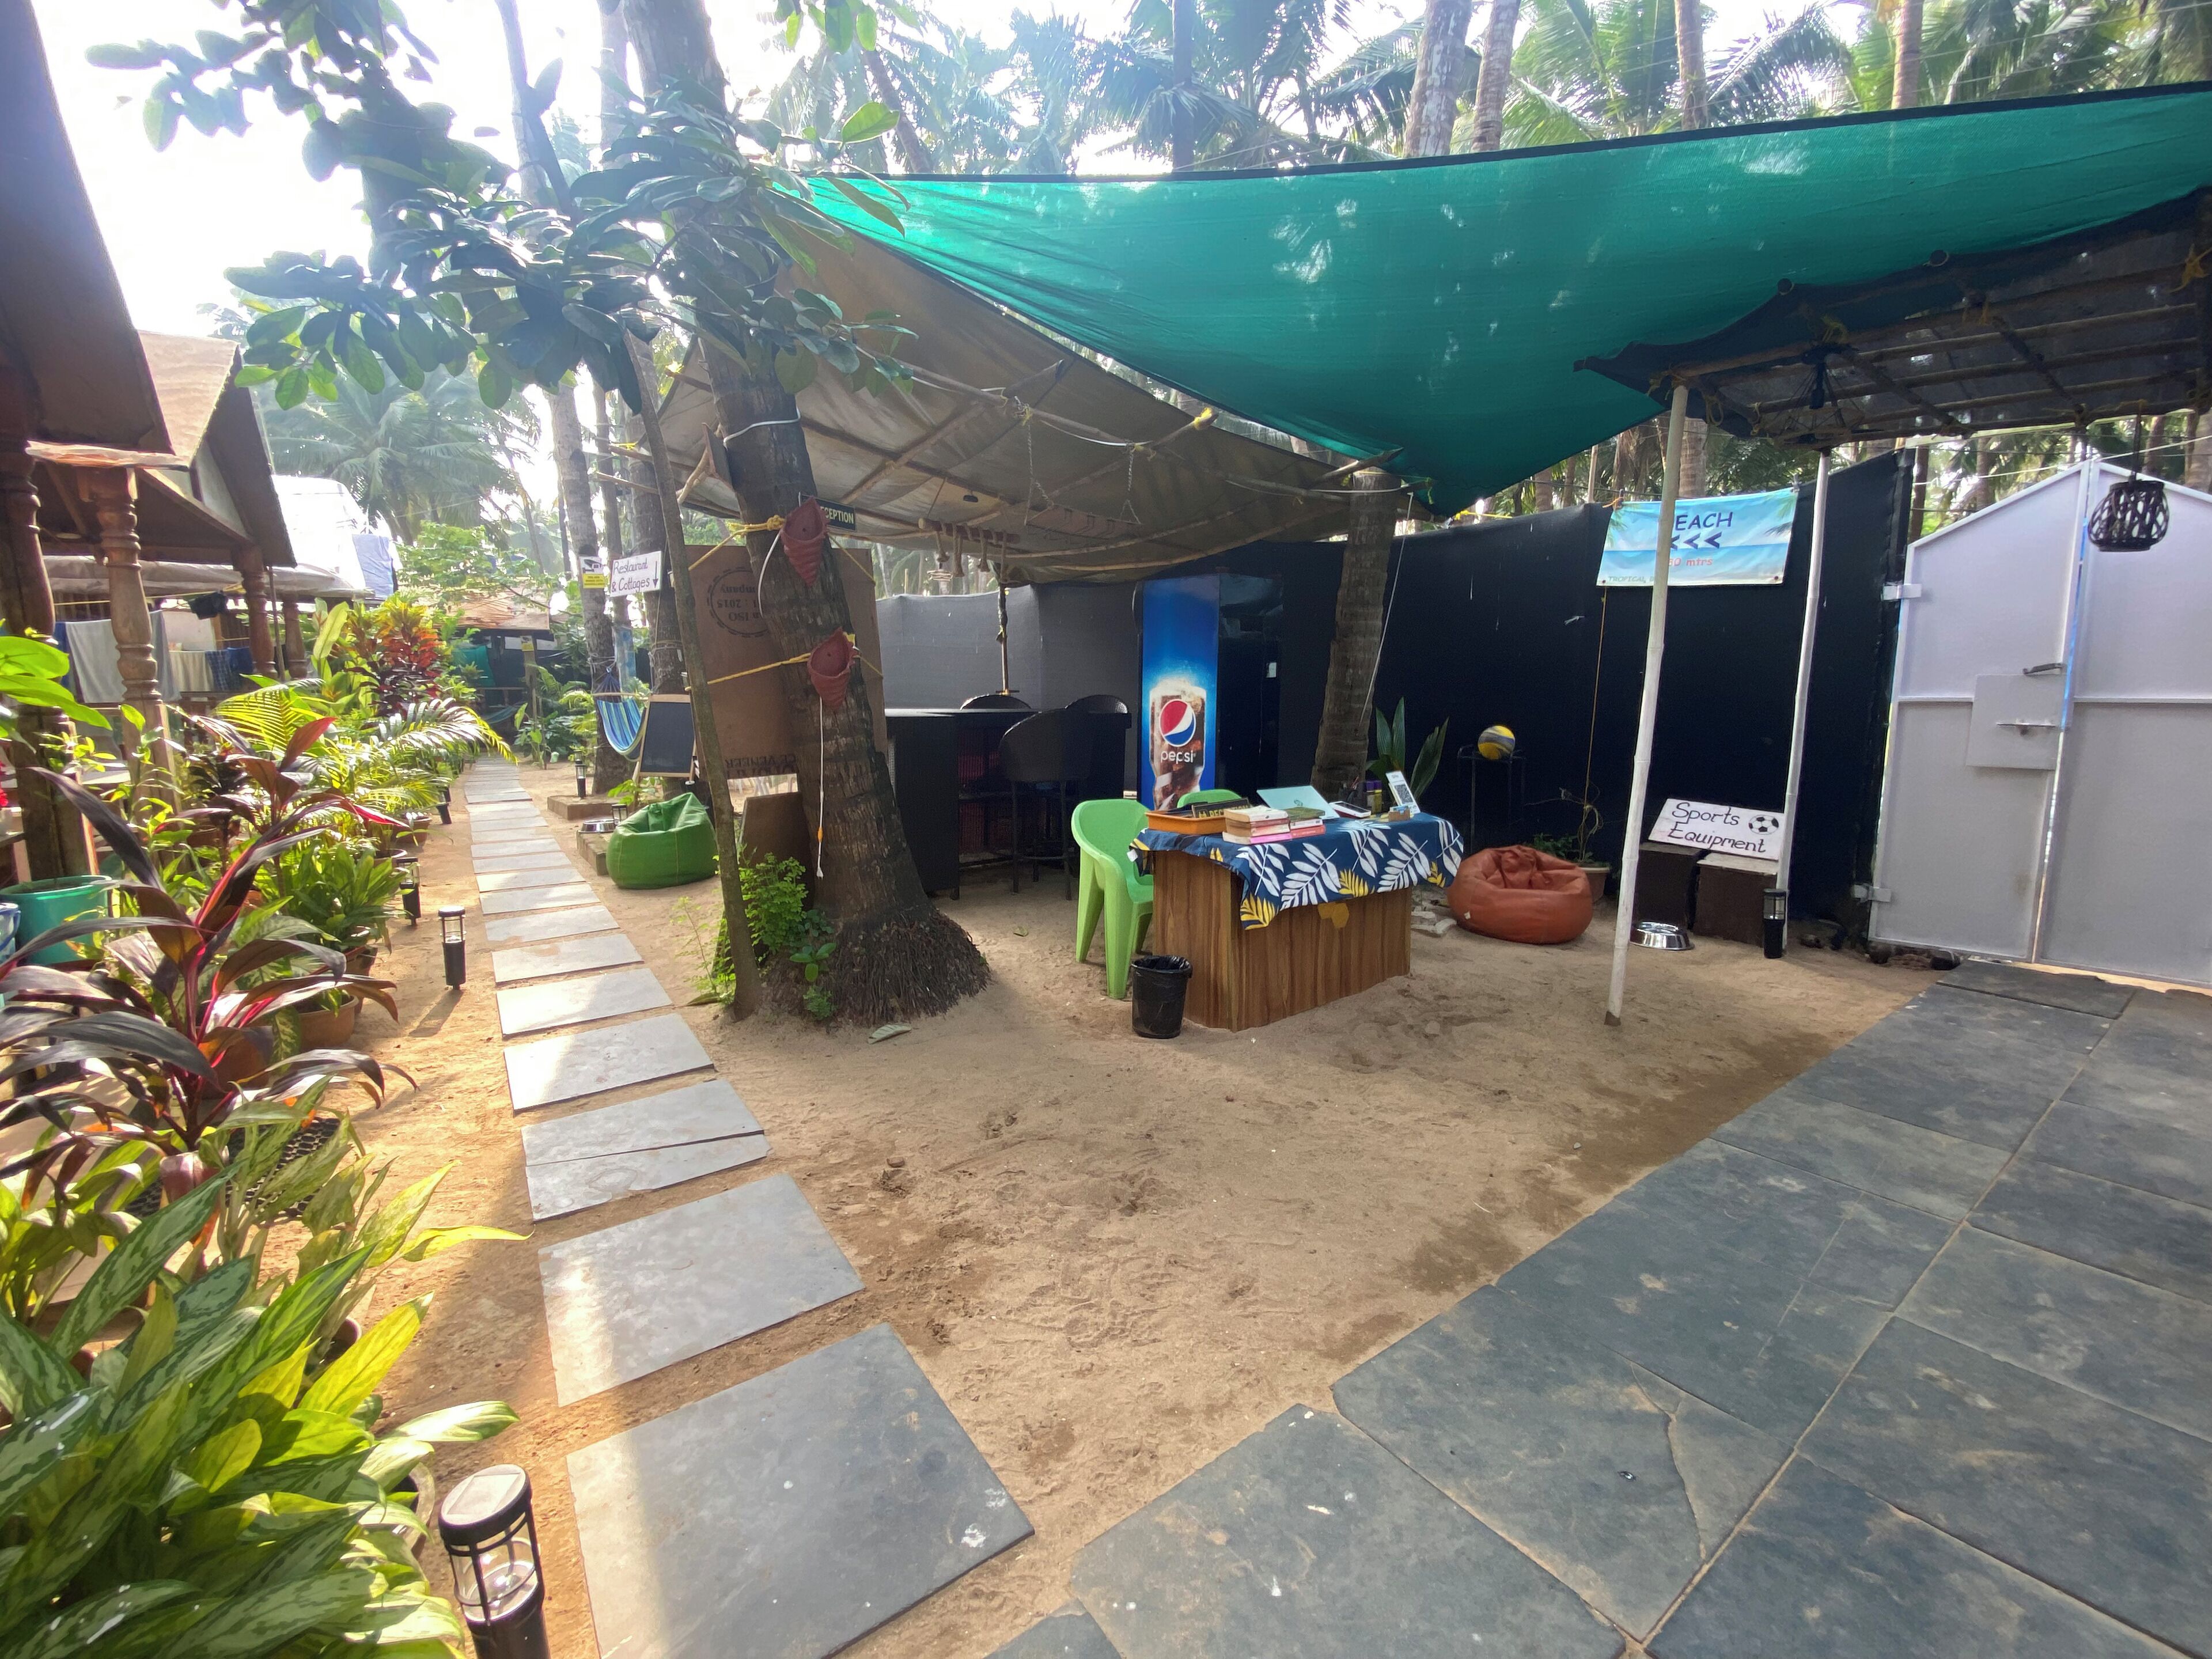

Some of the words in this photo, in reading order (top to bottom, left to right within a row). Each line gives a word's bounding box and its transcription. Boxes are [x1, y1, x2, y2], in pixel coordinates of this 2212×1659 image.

[820, 506, 854, 524] CEPTION
[1675, 512, 1733, 531] EACH
[613, 558, 649, 575] Restaurant
[611, 582, 616, 592] &
[619, 578, 650, 592] Cottages
[721, 584, 756, 593] mpany
[1160, 750, 1194, 764] pepsi
[1672, 802, 1740, 825] Sports
[1668, 821, 1766, 853] Equipment
